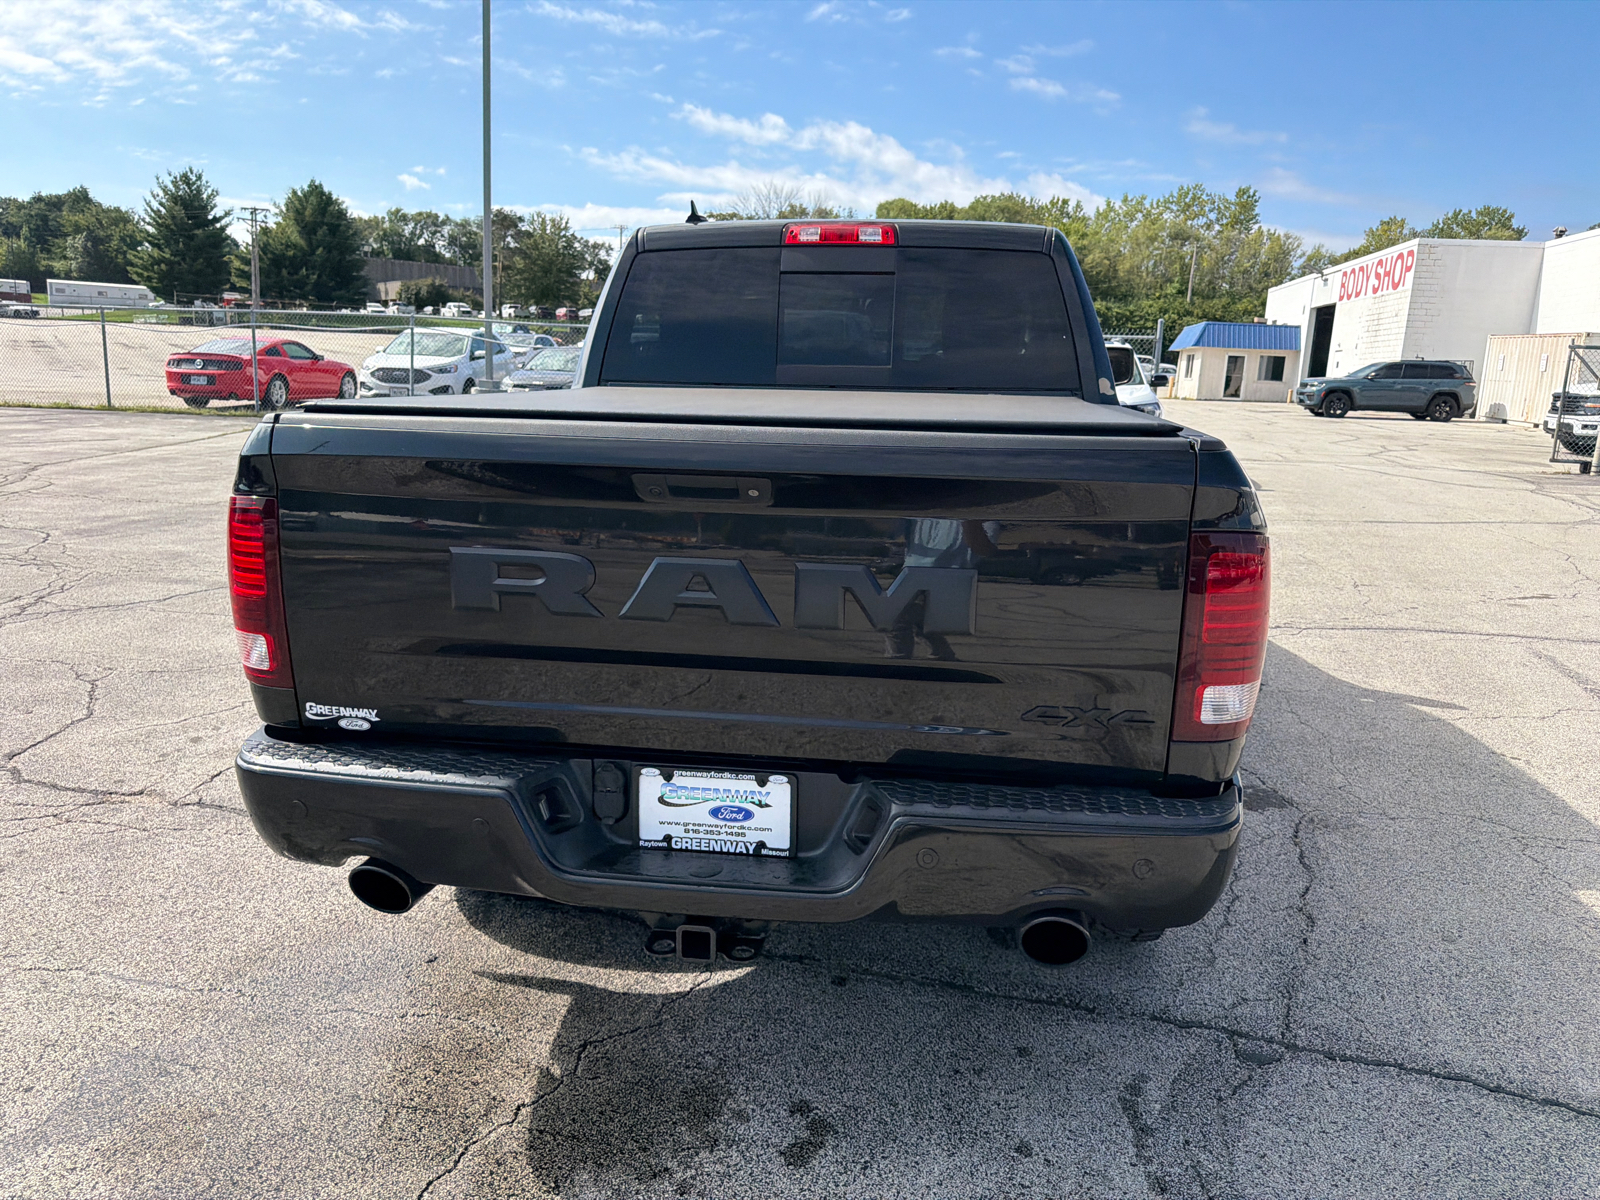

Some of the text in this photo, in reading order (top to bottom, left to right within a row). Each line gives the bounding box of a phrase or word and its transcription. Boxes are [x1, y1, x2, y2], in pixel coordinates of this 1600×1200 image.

[449, 546, 978, 635] RAM
[305, 702, 378, 718] GREENWAY
[673, 770, 756, 780] greenwayfordkc.com
[660, 782, 771, 805] GREENWAY
[718, 807, 745, 820] Ford
[658, 820, 773, 832] www.greenwayfordkc.com
[683, 828, 747, 838] 816-353-1495
[639, 836, 790, 857] Raytown GREENWAY Missouri
